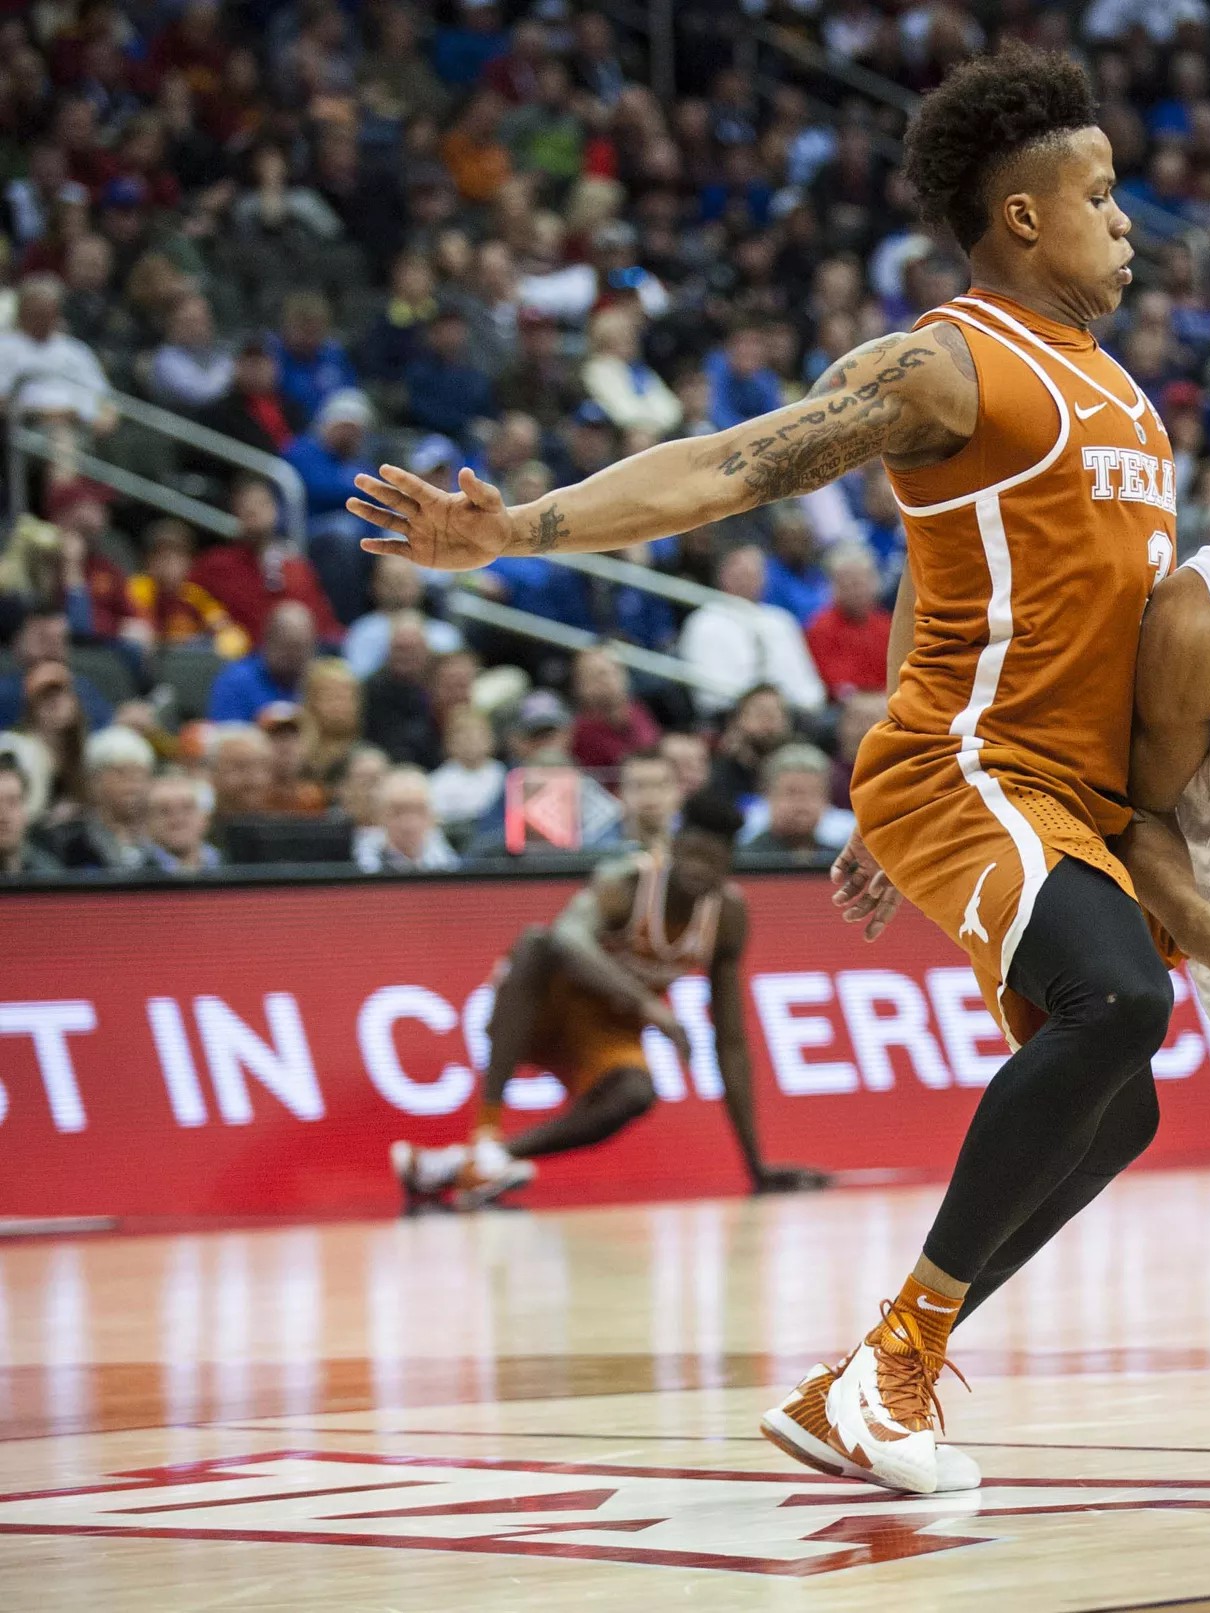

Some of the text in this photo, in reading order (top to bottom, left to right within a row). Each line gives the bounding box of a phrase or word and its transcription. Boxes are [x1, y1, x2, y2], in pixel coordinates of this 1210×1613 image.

[828, 347, 936, 415] GODS
[718, 410, 826, 477] PLAN
[1081, 446, 1177, 516] TEXA
[0, 1000, 97, 1133] T
[145, 991, 326, 1127] IN
